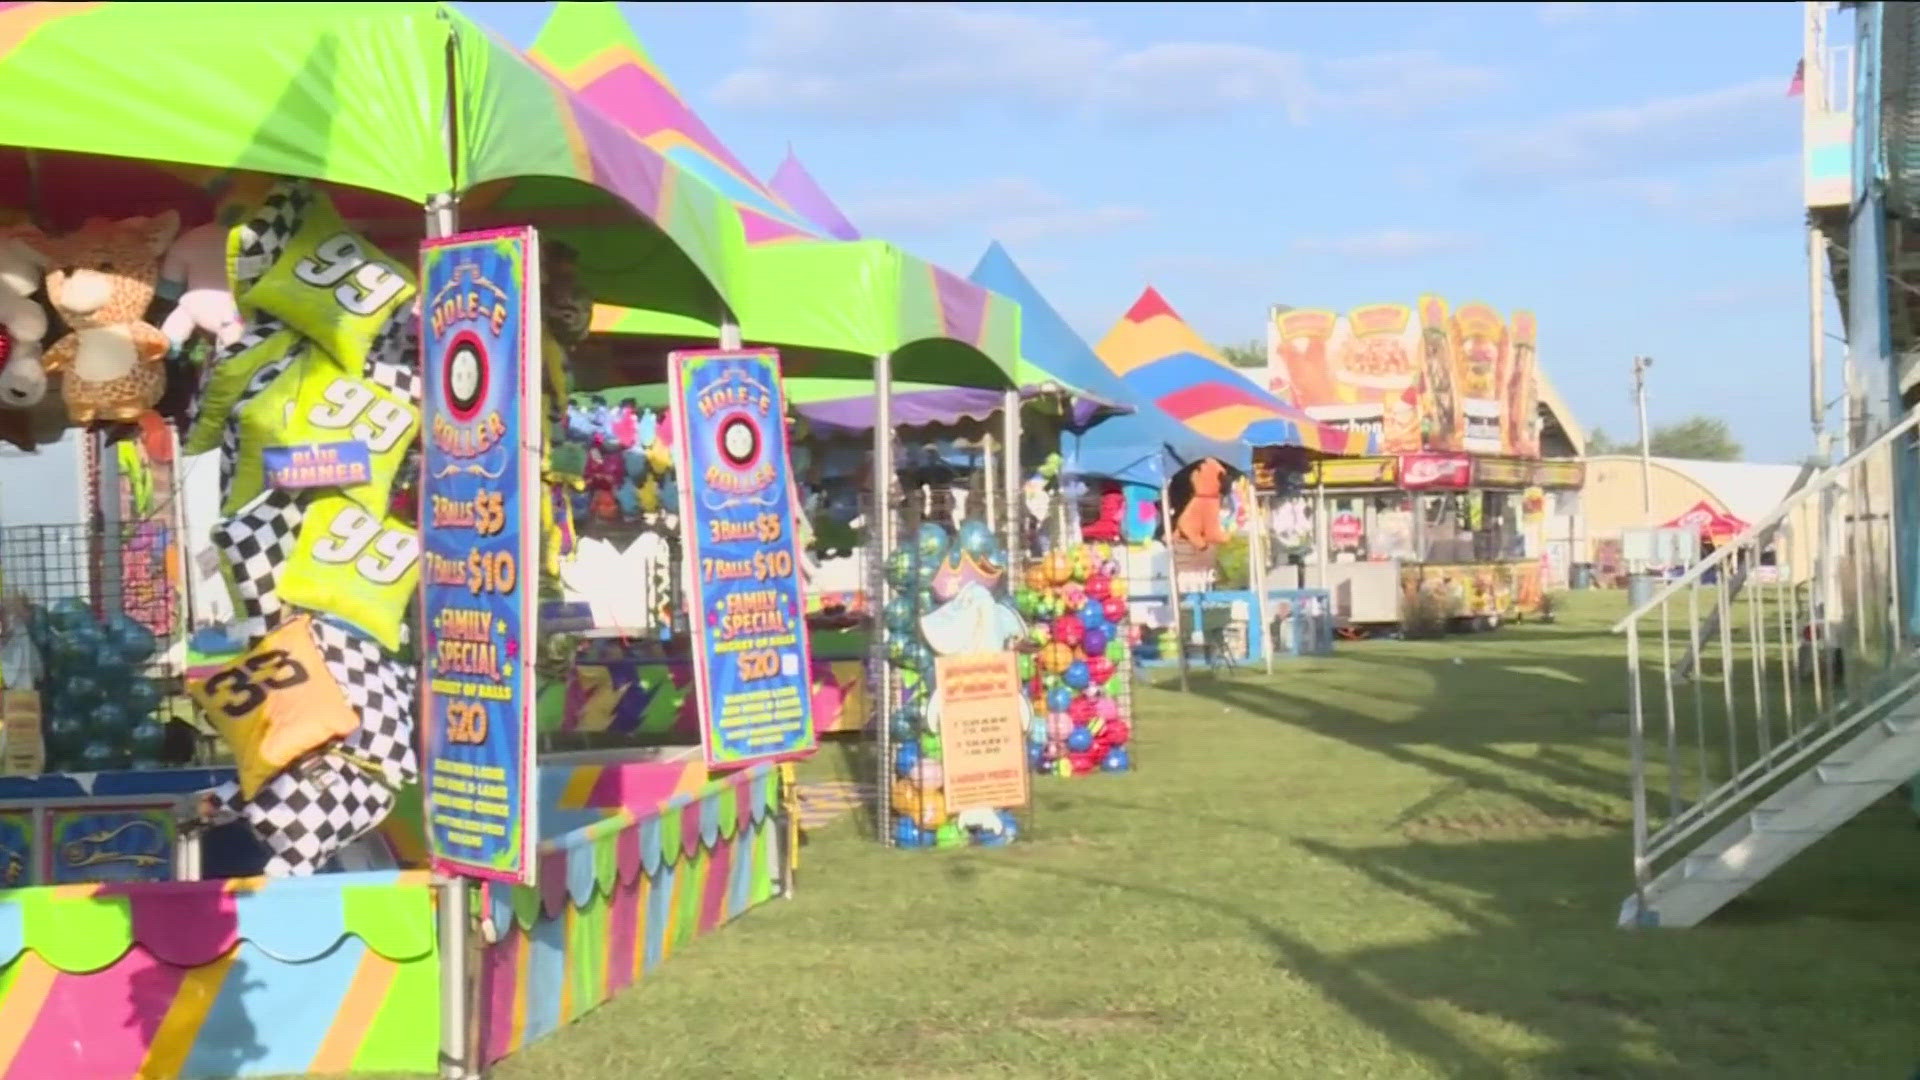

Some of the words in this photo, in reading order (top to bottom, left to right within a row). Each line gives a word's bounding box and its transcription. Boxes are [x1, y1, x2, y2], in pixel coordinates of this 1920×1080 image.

[294, 233, 406, 315] 99
[430, 291, 507, 340] HOLE-E
[308, 376, 414, 454] 99
[697, 387, 771, 418] HOLE-E
[433, 411, 507, 459] ROLLER
[705, 464, 777, 495] ROLLER
[474, 487, 506, 536] $5
[757, 512, 781, 542] $5
[311, 506, 419, 586] 99
[715, 558, 752, 580] BALLS
[754, 550, 793, 582] $10
[467, 546, 516, 595] $10
[725, 590, 778, 614] FAMILY
[441, 608, 493, 643] FAMILY
[721, 610, 788, 640] SPECIAL
[437, 639, 500, 683] SPECIAL
[738, 649, 780, 682] $20
[205, 650, 309, 717] 33
[445, 700, 488, 744] $20
